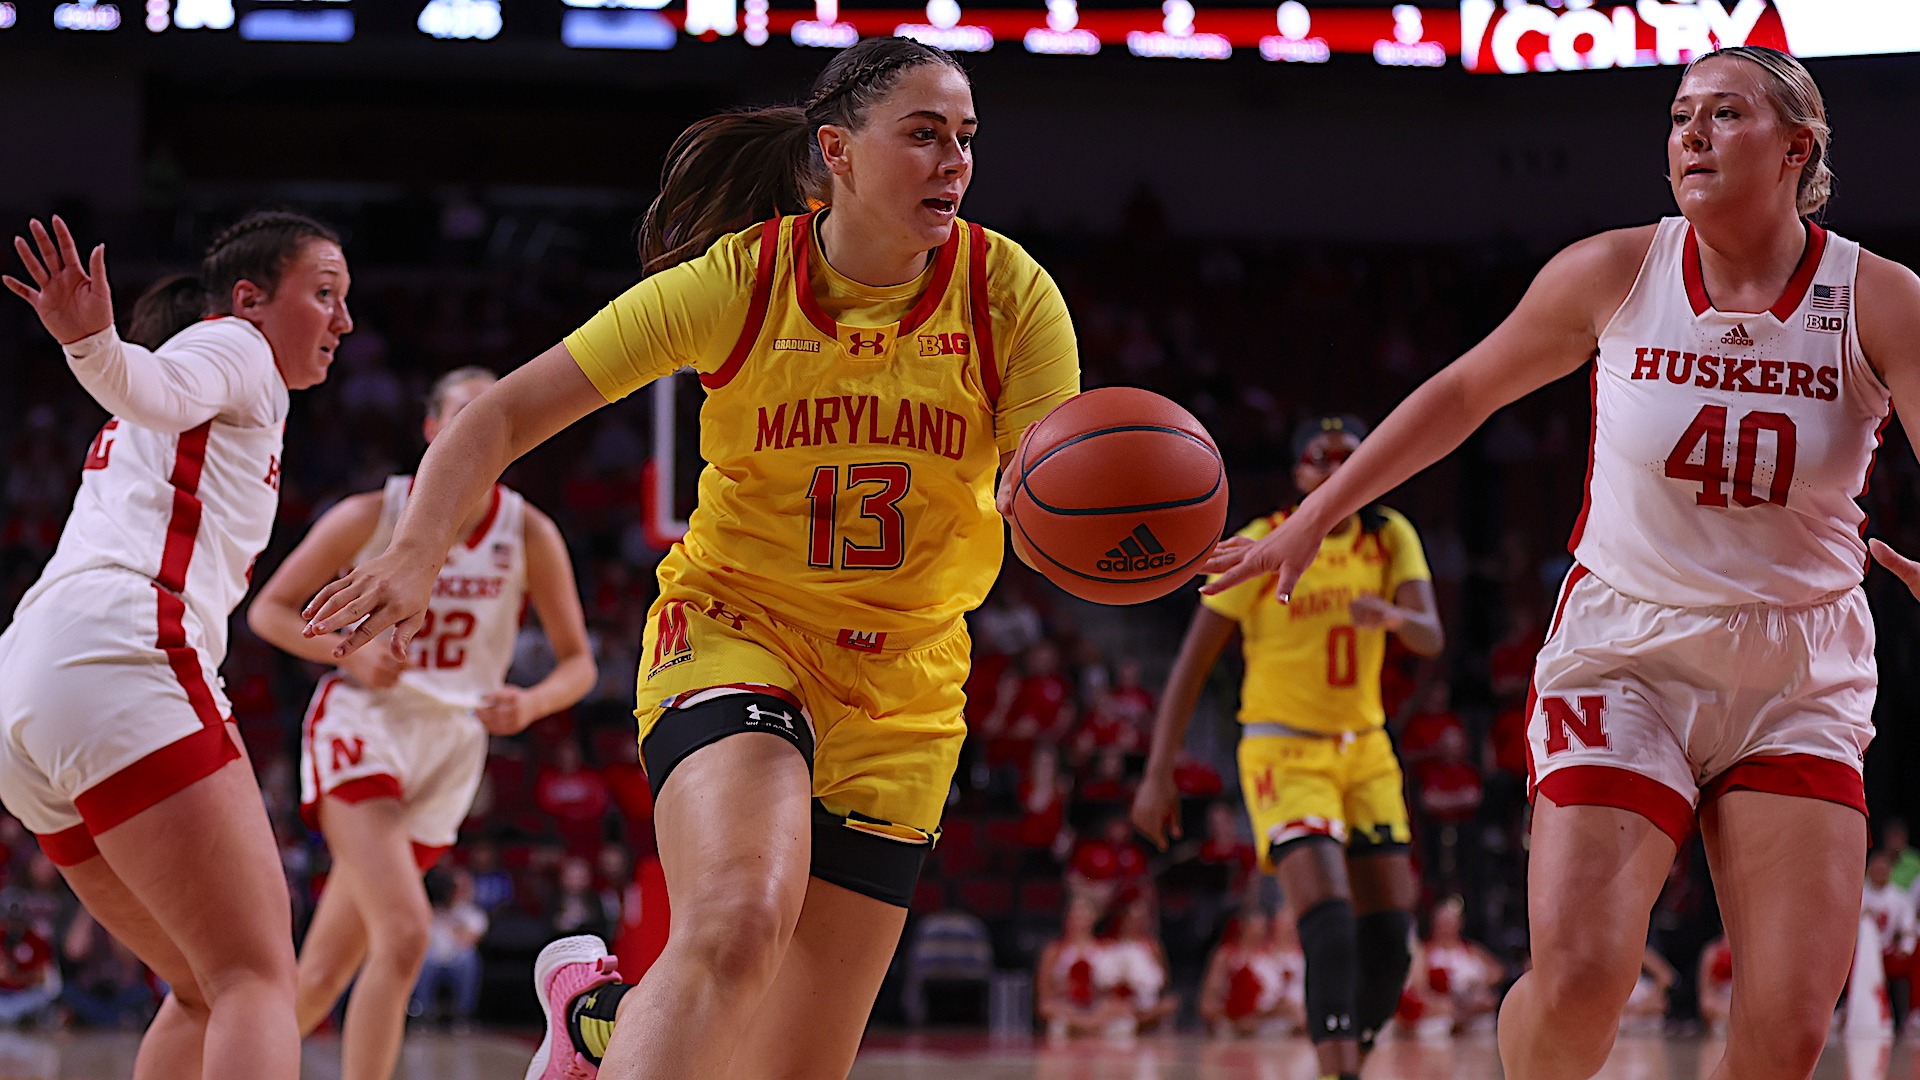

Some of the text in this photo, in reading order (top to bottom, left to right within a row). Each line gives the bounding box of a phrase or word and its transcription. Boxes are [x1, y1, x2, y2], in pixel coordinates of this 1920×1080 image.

[774, 339, 819, 352] GRADUATE
[1720, 336, 1754, 347] adidas
[1631, 347, 1839, 401] HUSKERS
[754, 395, 967, 460] MARYLAND
[1664, 404, 1797, 508] 40
[805, 461, 912, 570] 13
[1096, 552, 1176, 572] adidas
[650, 602, 692, 671] M
[1327, 624, 1357, 688] 0
[331, 737, 363, 770] N
[1540, 695, 1611, 757] N
